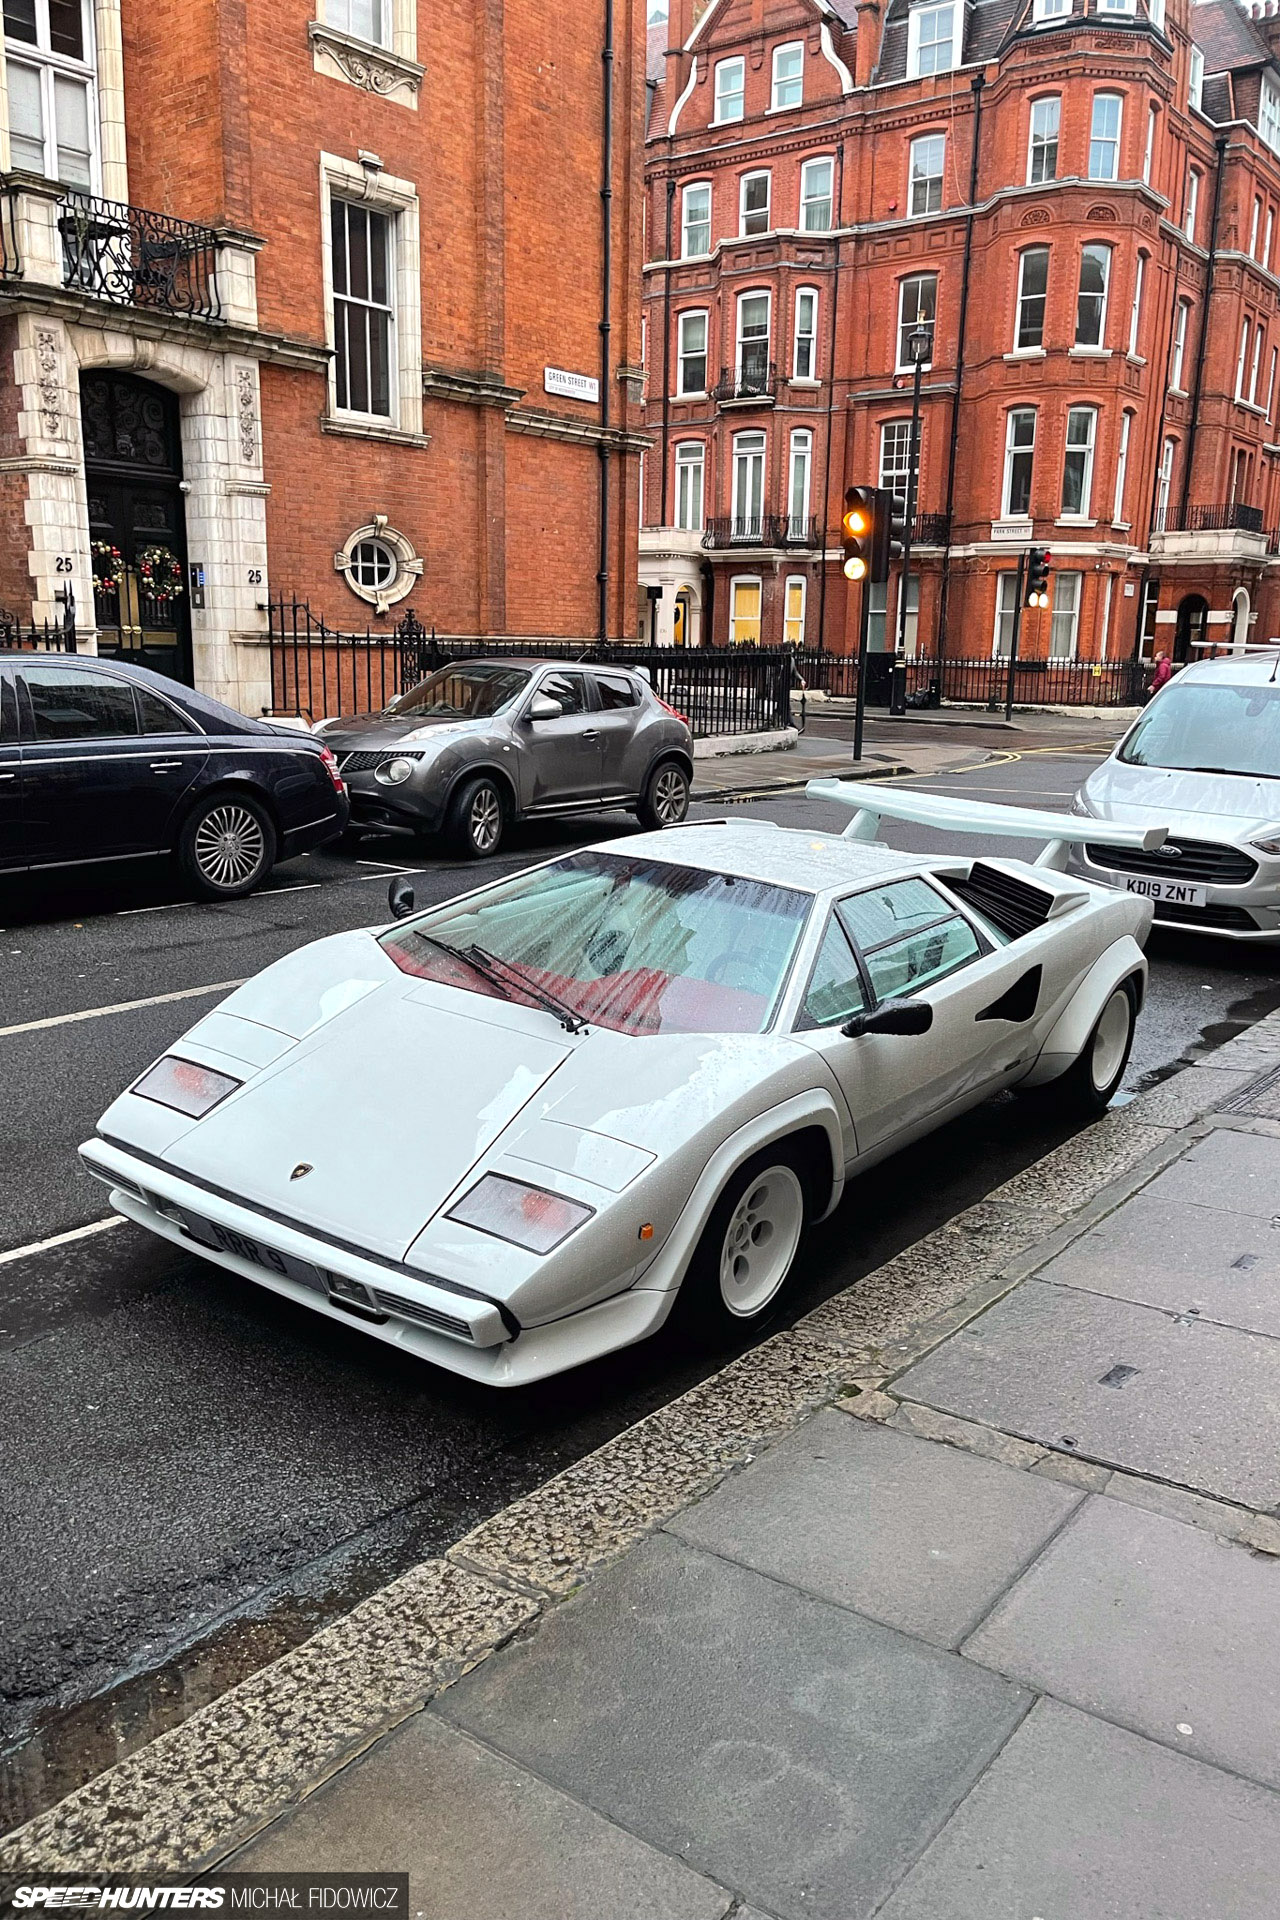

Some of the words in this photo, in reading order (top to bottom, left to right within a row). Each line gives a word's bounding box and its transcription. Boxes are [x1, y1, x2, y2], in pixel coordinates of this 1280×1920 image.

[548, 372, 567, 384] GREEN
[568, 376, 587, 388] STREET
[55, 557, 73, 572] 25
[248, 569, 262, 584] 25
[1126, 878, 1162, 897] KD19
[1165, 885, 1198, 902] ZNT
[209, 1223, 265, 1265] RRR
[266, 1249, 288, 1274] 9
